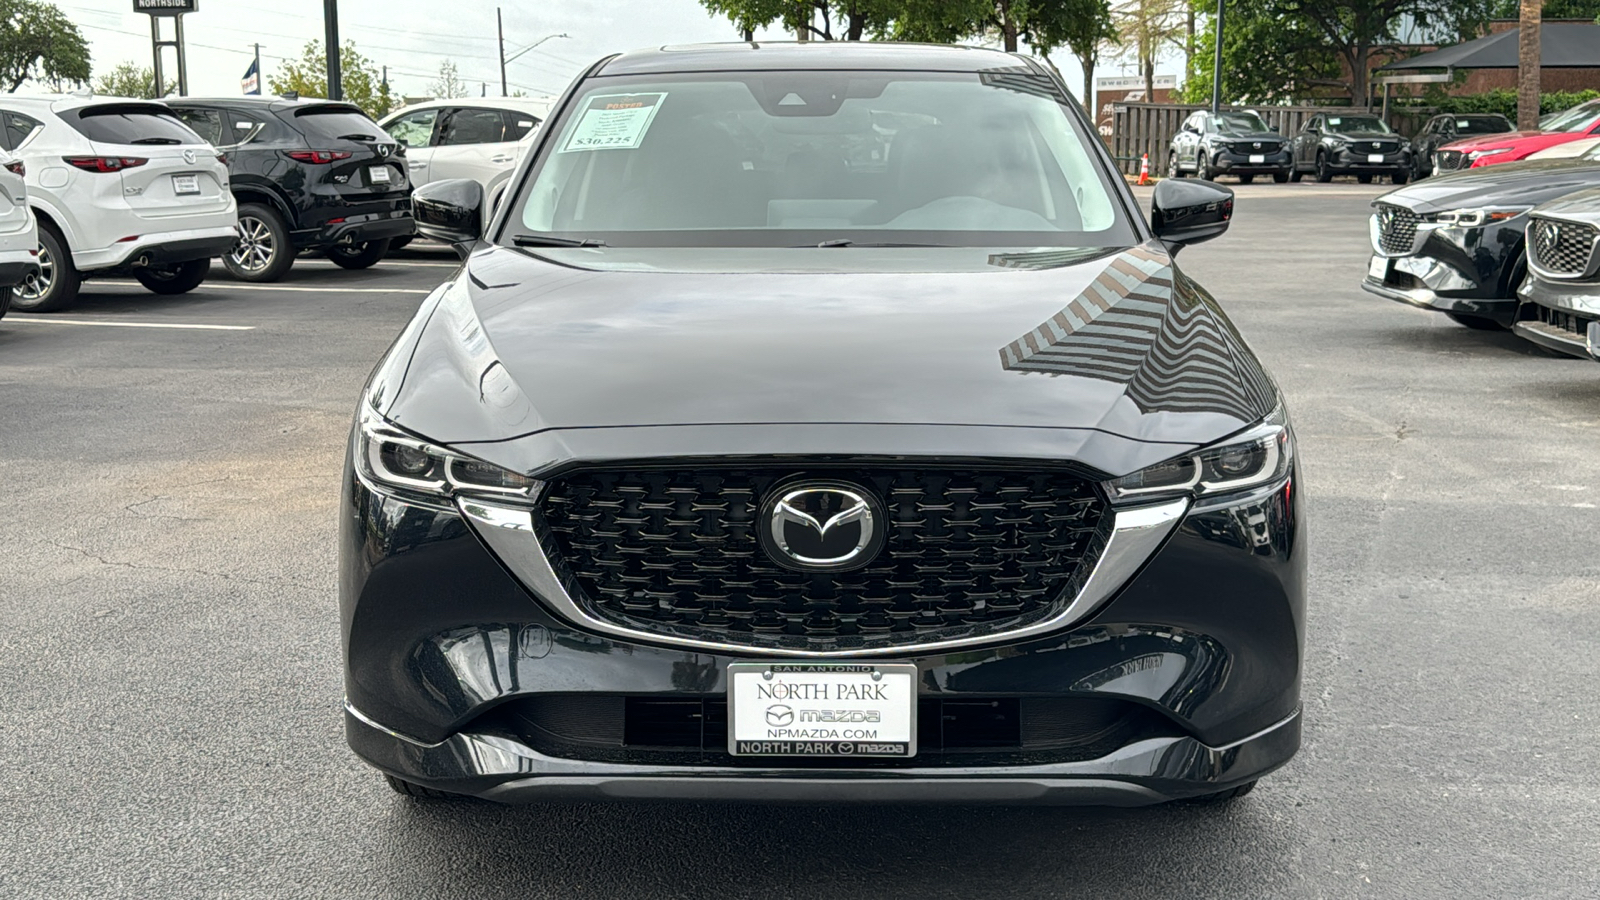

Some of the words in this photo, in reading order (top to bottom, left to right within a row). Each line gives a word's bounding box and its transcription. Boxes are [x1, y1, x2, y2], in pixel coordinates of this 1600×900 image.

[757, 681, 828, 701] NORTH
[836, 683, 888, 700] PARK
[800, 709, 880, 722] mazda
[740, 742, 790, 753] NORTH
[796, 743, 834, 754] PARK
[858, 744, 904, 753] mazda
